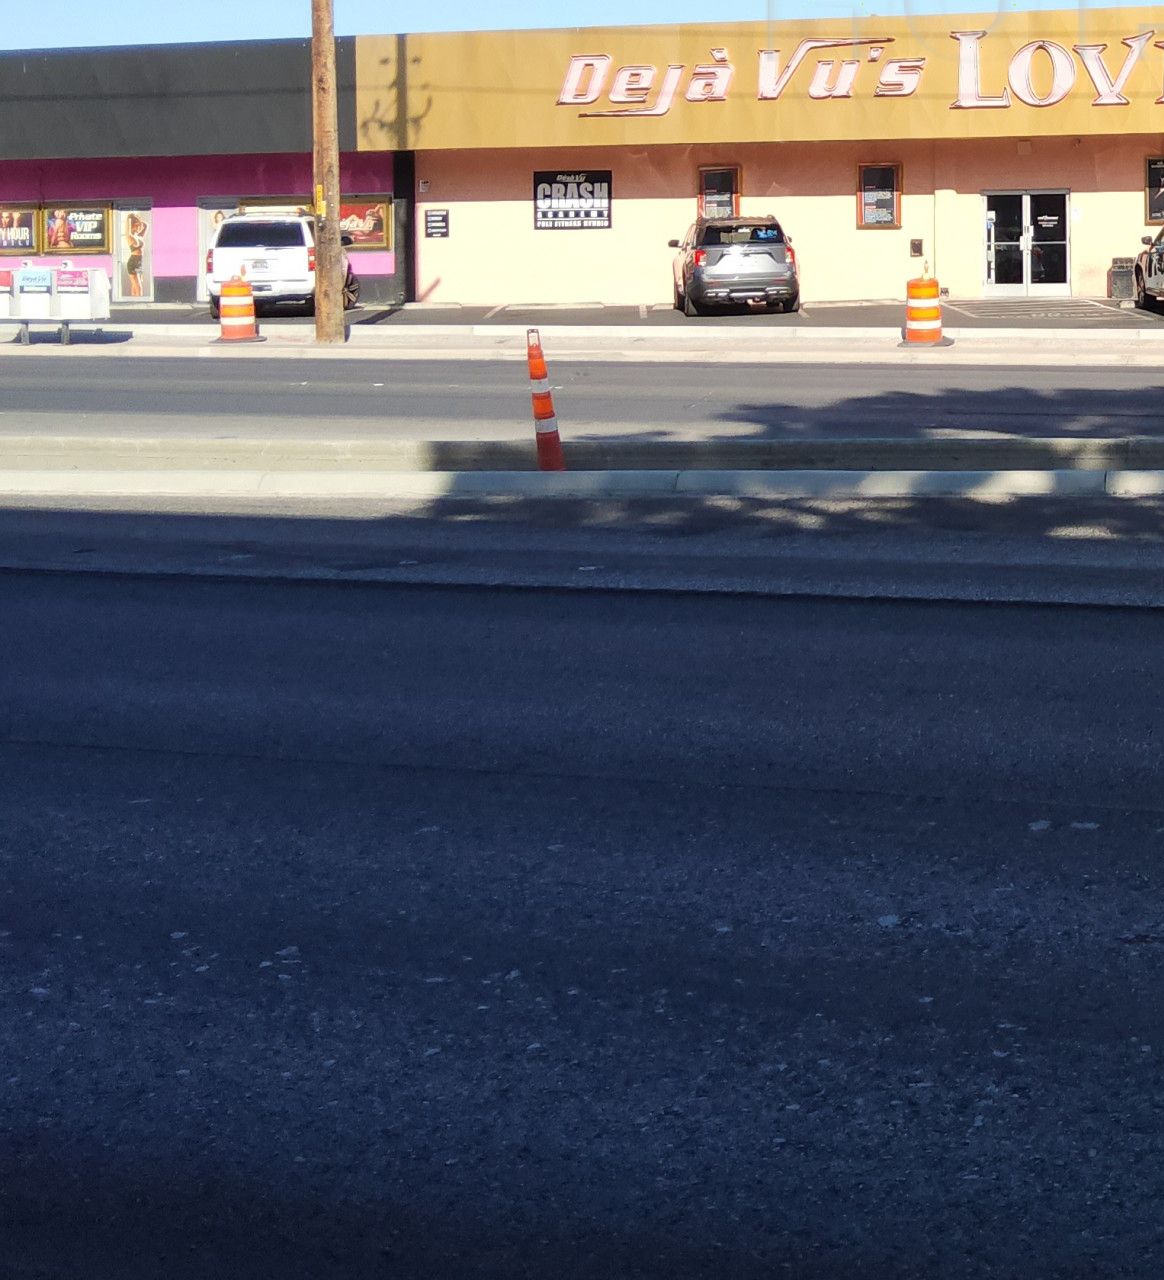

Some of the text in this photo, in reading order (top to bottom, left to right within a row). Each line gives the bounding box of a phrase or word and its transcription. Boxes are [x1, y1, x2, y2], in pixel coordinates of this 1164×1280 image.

[758, 36, 926, 100] Vu's
[536, 182, 609, 209] CRASH
[68, 212, 103, 221] Private
[75, 220, 98, 233] VIP
[7, 227, 30, 240] HOUR
[70, 232, 103, 240] Rooms
